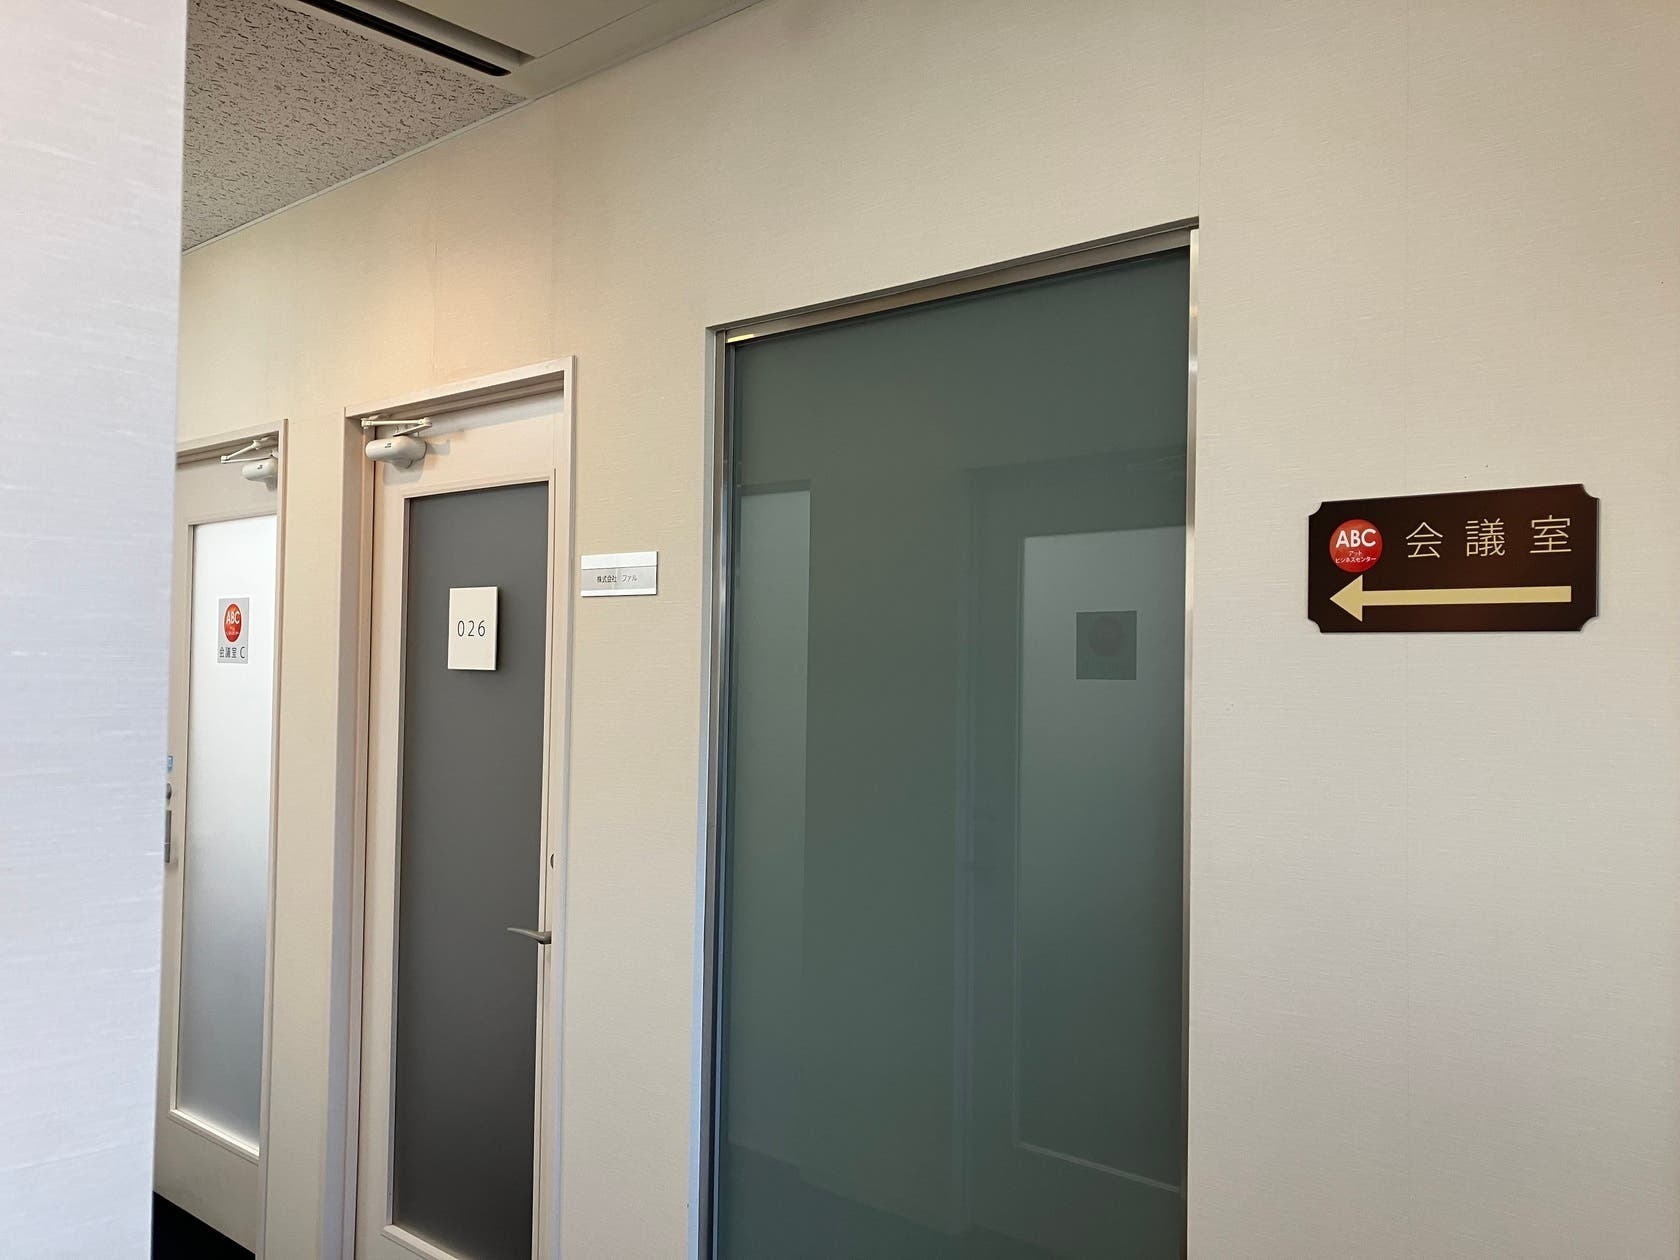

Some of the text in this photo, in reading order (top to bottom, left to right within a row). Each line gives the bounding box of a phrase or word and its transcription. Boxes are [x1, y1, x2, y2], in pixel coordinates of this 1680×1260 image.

[1335, 528, 1377, 549] ABC
[1406, 514, 1572, 559] 会議室
[225, 611, 240, 624] ABC
[457, 620, 486, 637] 026
[239, 646, 245, 659] C
